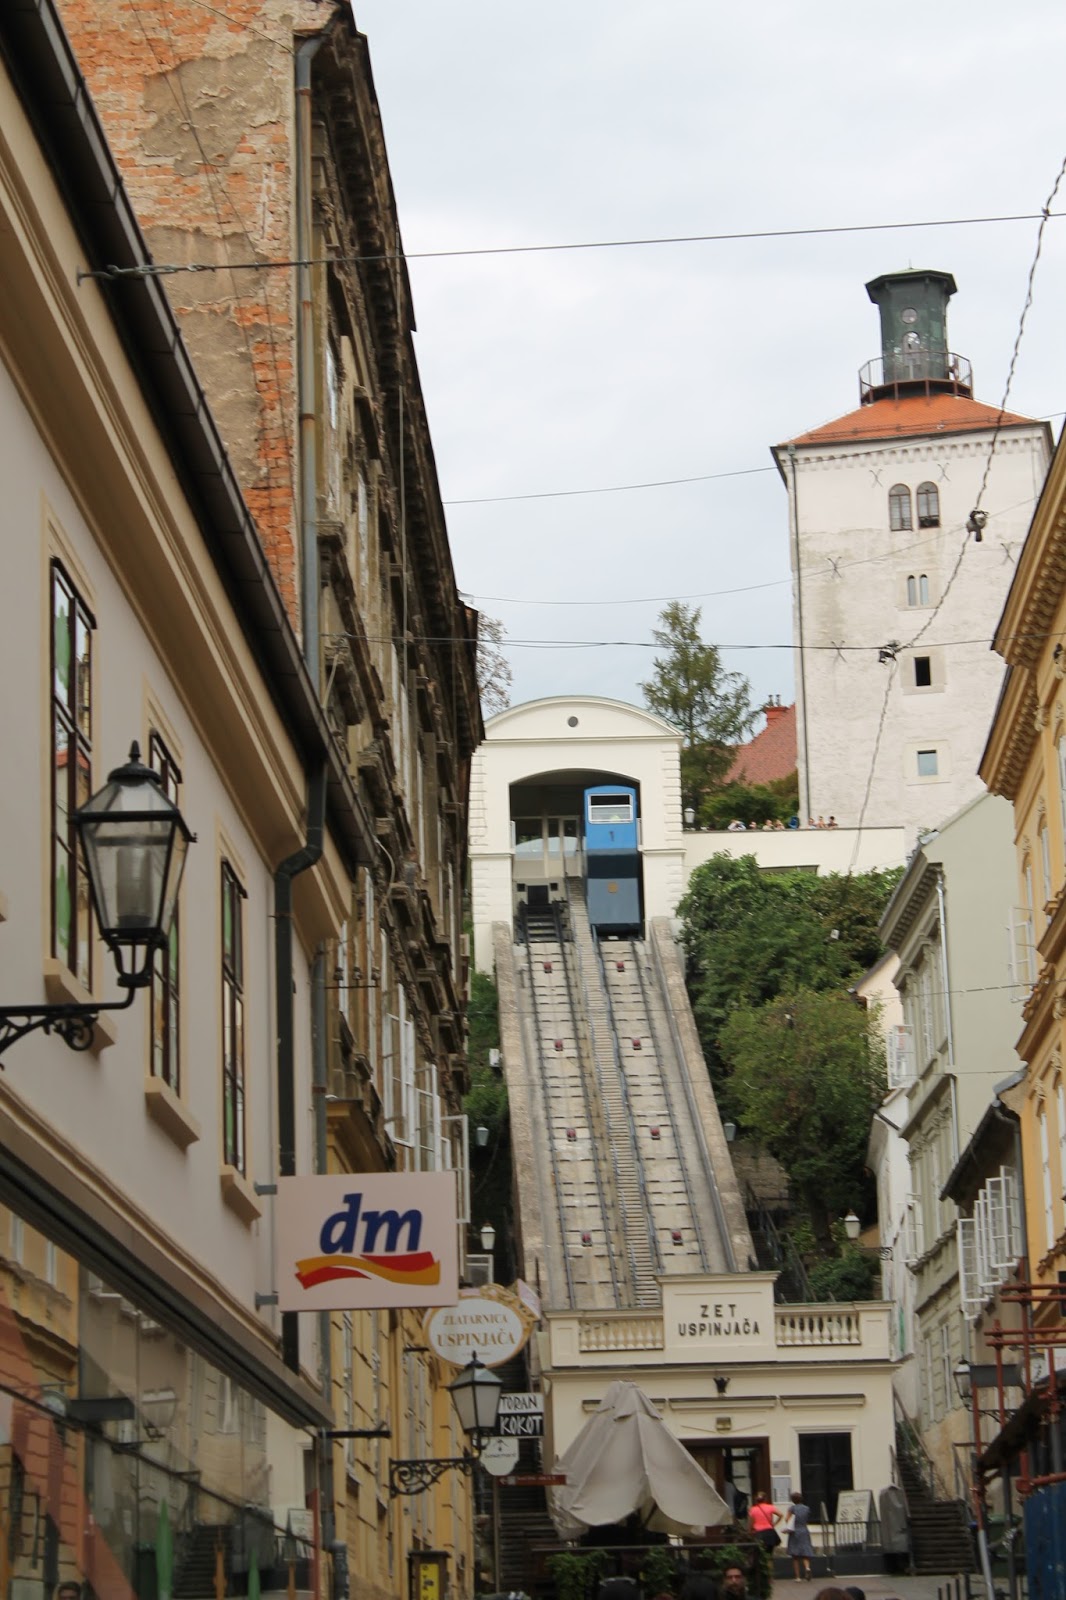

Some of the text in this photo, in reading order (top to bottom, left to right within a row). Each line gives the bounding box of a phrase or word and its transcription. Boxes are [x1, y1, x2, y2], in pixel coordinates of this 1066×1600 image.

[318, 1192, 423, 1255] dm
[443, 1313, 508, 1326] ZLATARNICA
[700, 1304, 736, 1318] ZET
[678, 1318, 760, 1337] USPINJAČA
[437, 1328, 516, 1347] USPINJAČA
[499, 1395, 538, 1411] TORAN
[500, 1415, 543, 1435] KOKOT
